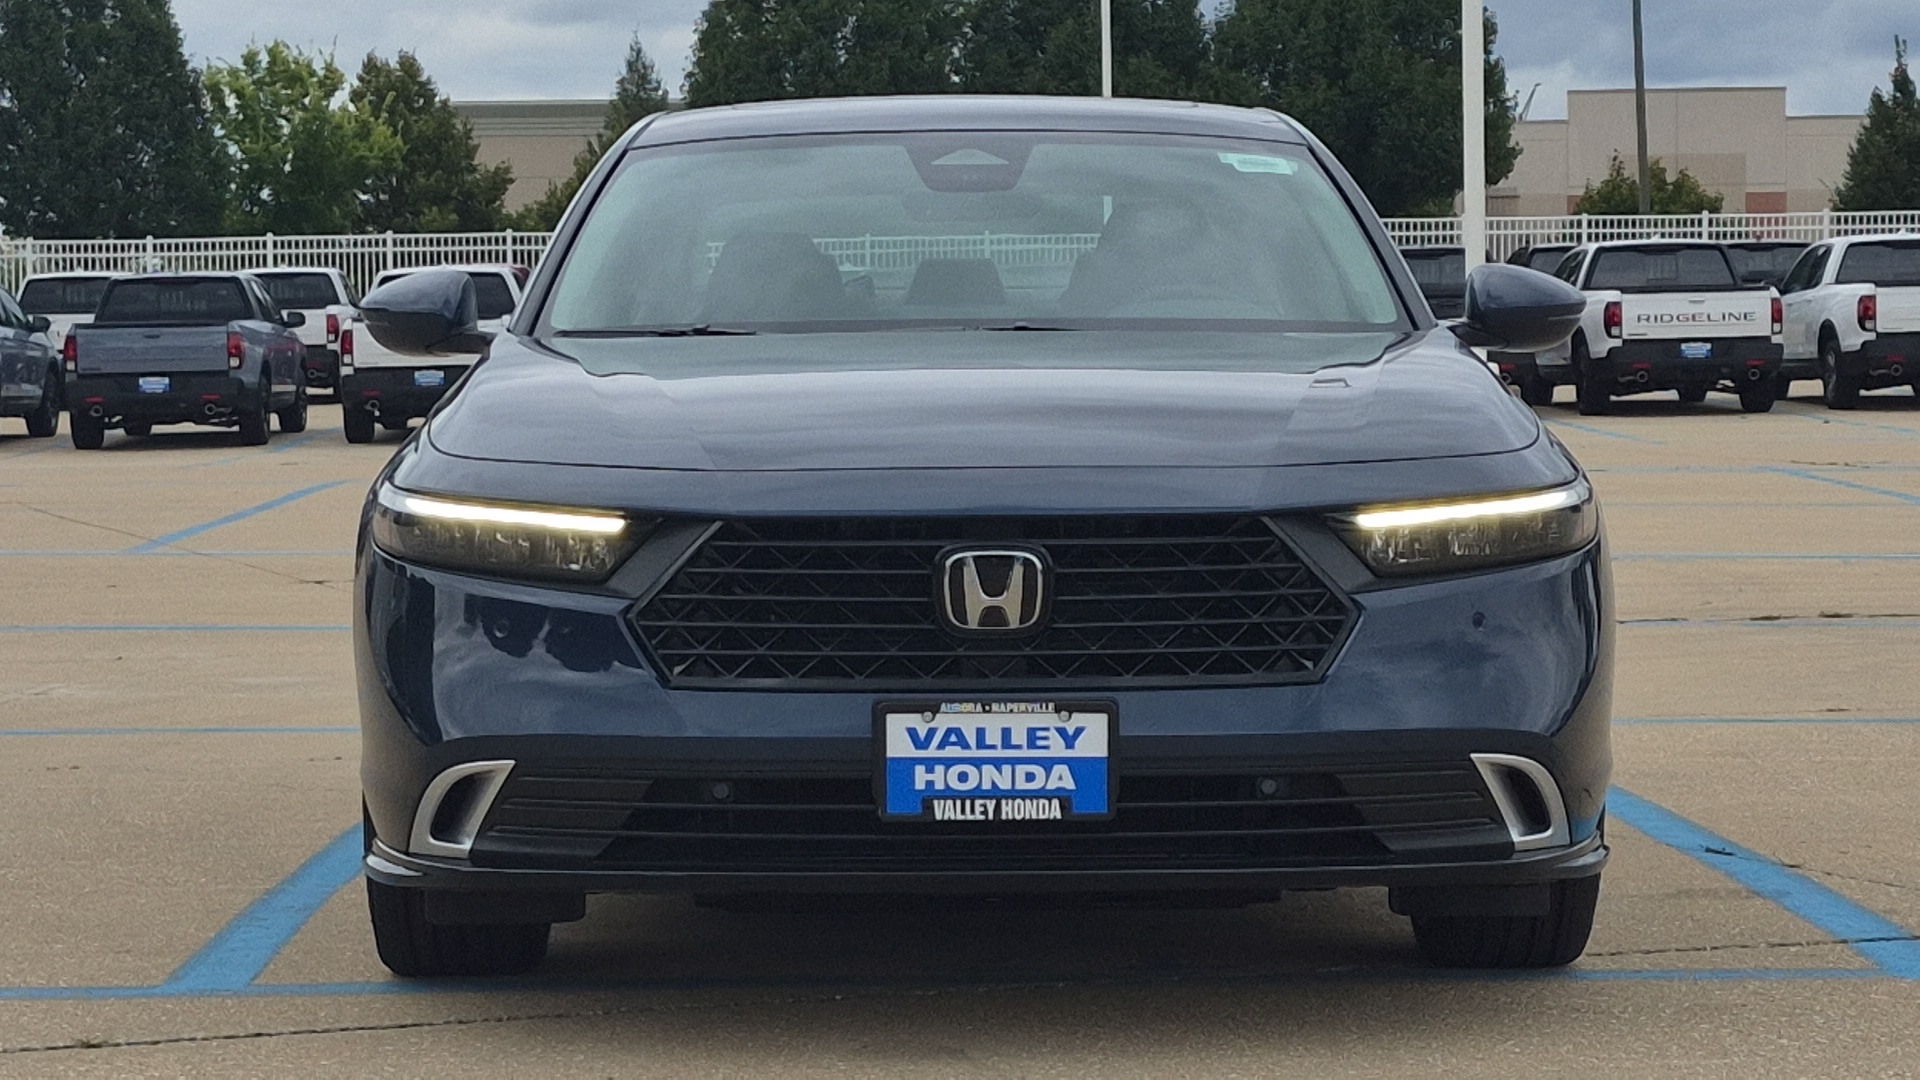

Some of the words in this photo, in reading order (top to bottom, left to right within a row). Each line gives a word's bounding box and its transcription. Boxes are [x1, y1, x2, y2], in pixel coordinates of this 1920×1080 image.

[1637, 312, 1756, 324] RIDGELINE
[991, 702, 1055, 713] NAPERVILLE
[905, 726, 1087, 751] VALLEY
[914, 764, 1077, 791] HONDA
[933, 798, 996, 821] VALLEY
[1000, 798, 1063, 821] HONDA
